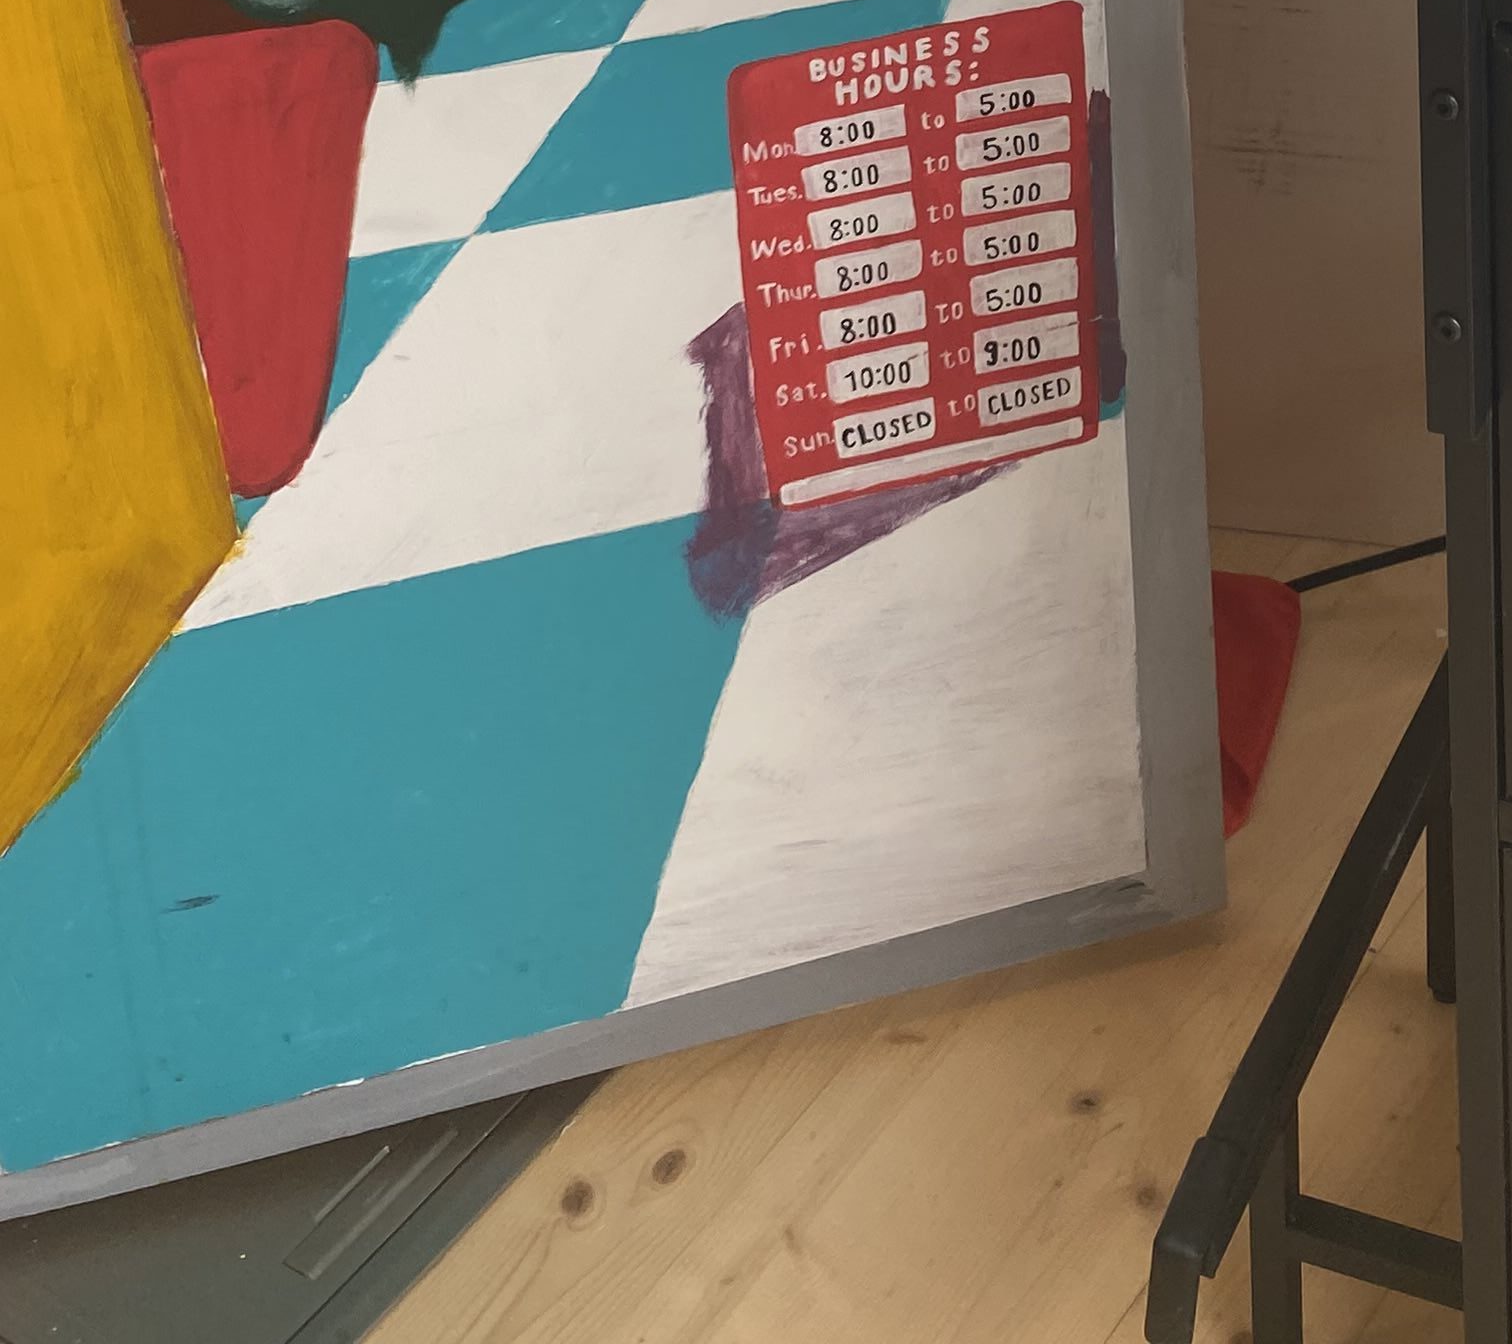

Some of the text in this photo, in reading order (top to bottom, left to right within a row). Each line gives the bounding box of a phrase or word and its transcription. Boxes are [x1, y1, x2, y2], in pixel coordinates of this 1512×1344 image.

[809, 24, 991, 82] BUSINESS
[834, 61, 979, 107] HOURS:
[819, 120, 876, 148] 8:00
[921, 111, 946, 131] to
[980, 89, 1036, 117] 5:00
[823, 163, 881, 193] 8:00
[924, 153, 950, 174] to
[982, 132, 1041, 161] 5:00
[751, 182, 1042, 261] Wed. 8:00 to 5:00
[837, 261, 889, 292] 8:00
[930, 245, 959, 266] to
[984, 231, 1041, 260] 5:00
[769, 281, 1043, 364] Fri. 8:00 to 5:00
[776, 381, 827, 407] Sat.
[843, 360, 912, 393] 10:00
[940, 344, 970, 368] to
[842, 410, 932, 450] CLOSED
[947, 395, 977, 416] to
[988, 376, 1072, 416] CLOSED
